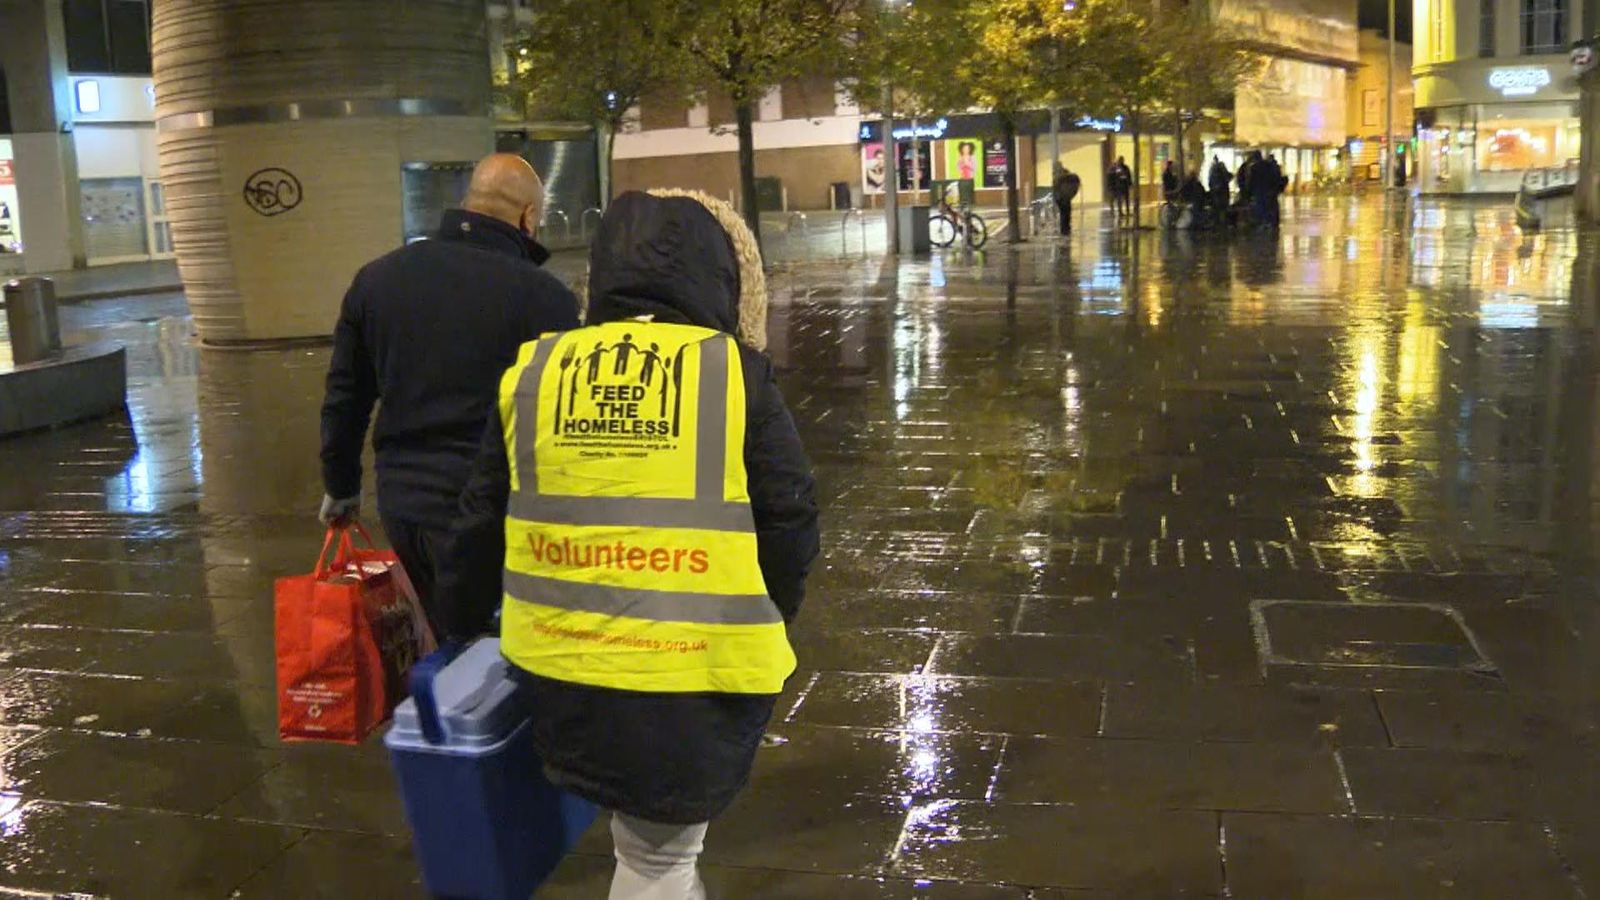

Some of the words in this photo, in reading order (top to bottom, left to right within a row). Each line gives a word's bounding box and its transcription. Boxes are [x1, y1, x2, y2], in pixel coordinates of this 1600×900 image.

[591, 385, 645, 401] FEED
[596, 402, 639, 418] THE
[564, 419, 670, 435] HOMELESS
[527, 532, 709, 574] Volunteers
